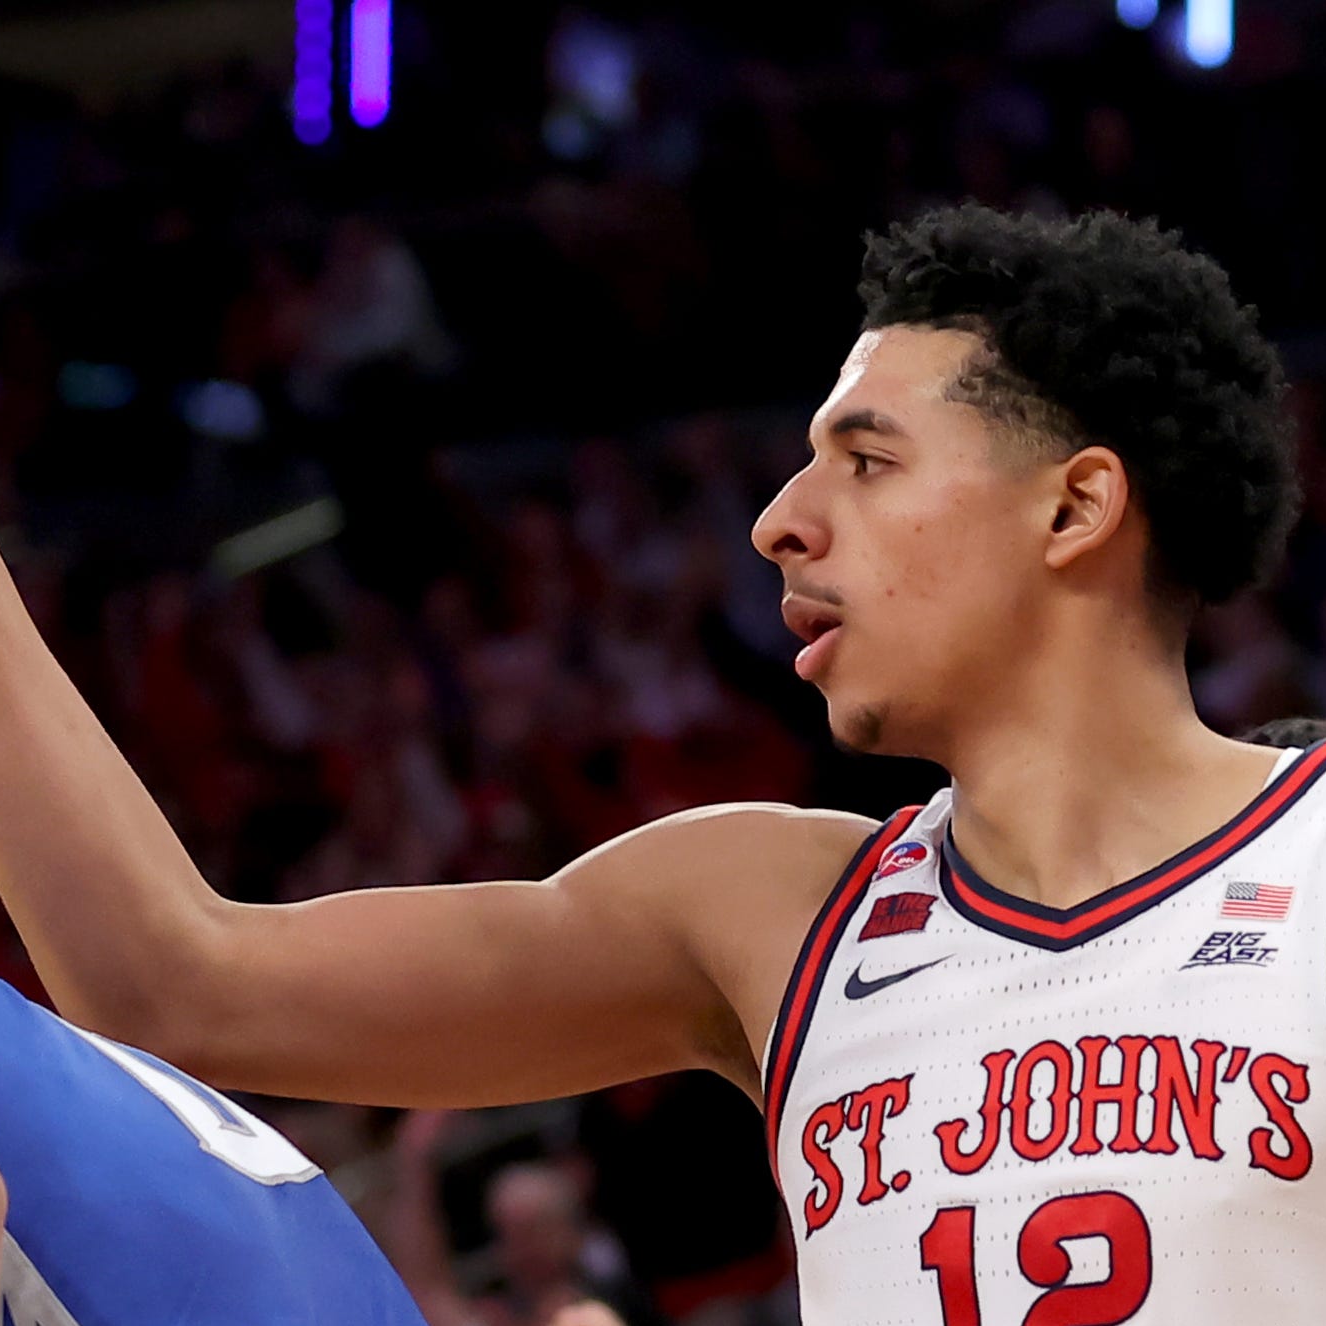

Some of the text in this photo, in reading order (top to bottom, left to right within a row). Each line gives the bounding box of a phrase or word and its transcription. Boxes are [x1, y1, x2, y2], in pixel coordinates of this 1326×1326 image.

[1201, 931, 1267, 947] BIG
[1188, 947, 1279, 963] EAST
[801, 1035, 1314, 1240] ST. JOHN'S
